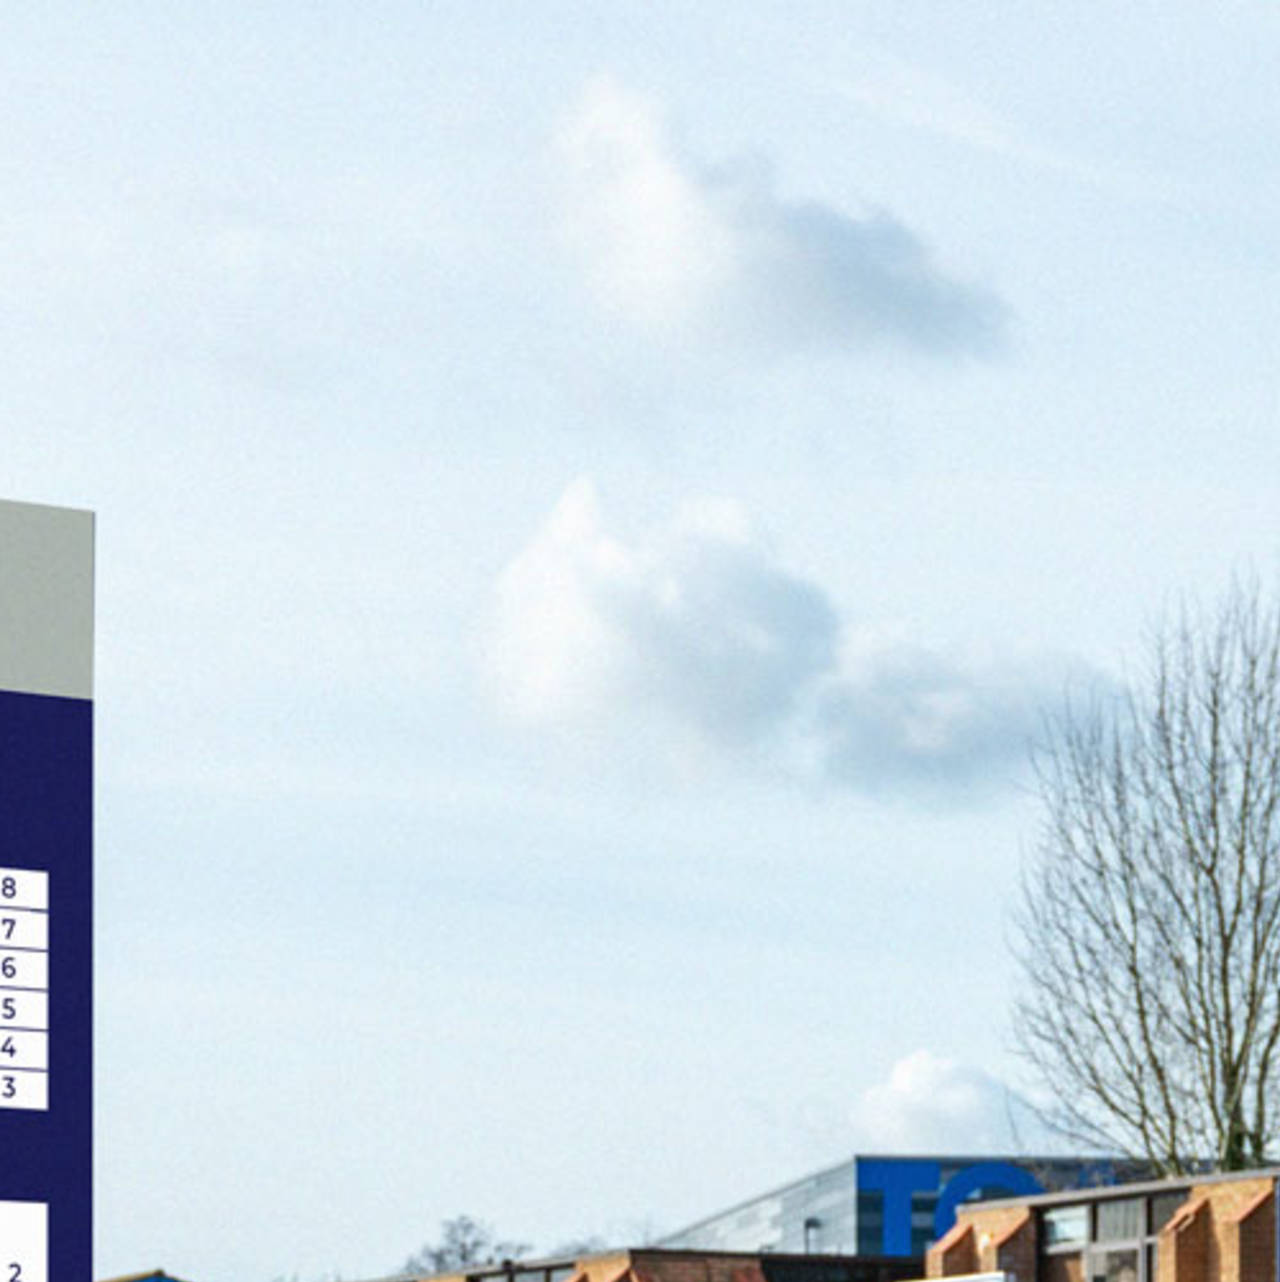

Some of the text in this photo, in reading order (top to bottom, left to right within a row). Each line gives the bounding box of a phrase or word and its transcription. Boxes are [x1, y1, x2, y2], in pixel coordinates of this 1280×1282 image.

[1, 876, 17, 899] 8
[1, 917, 17, 940] 7
[1, 956, 17, 979] 6
[1, 997, 17, 1020] 5
[0, 1036, 17, 1059] 4
[1, 1075, 17, 1099] 3
